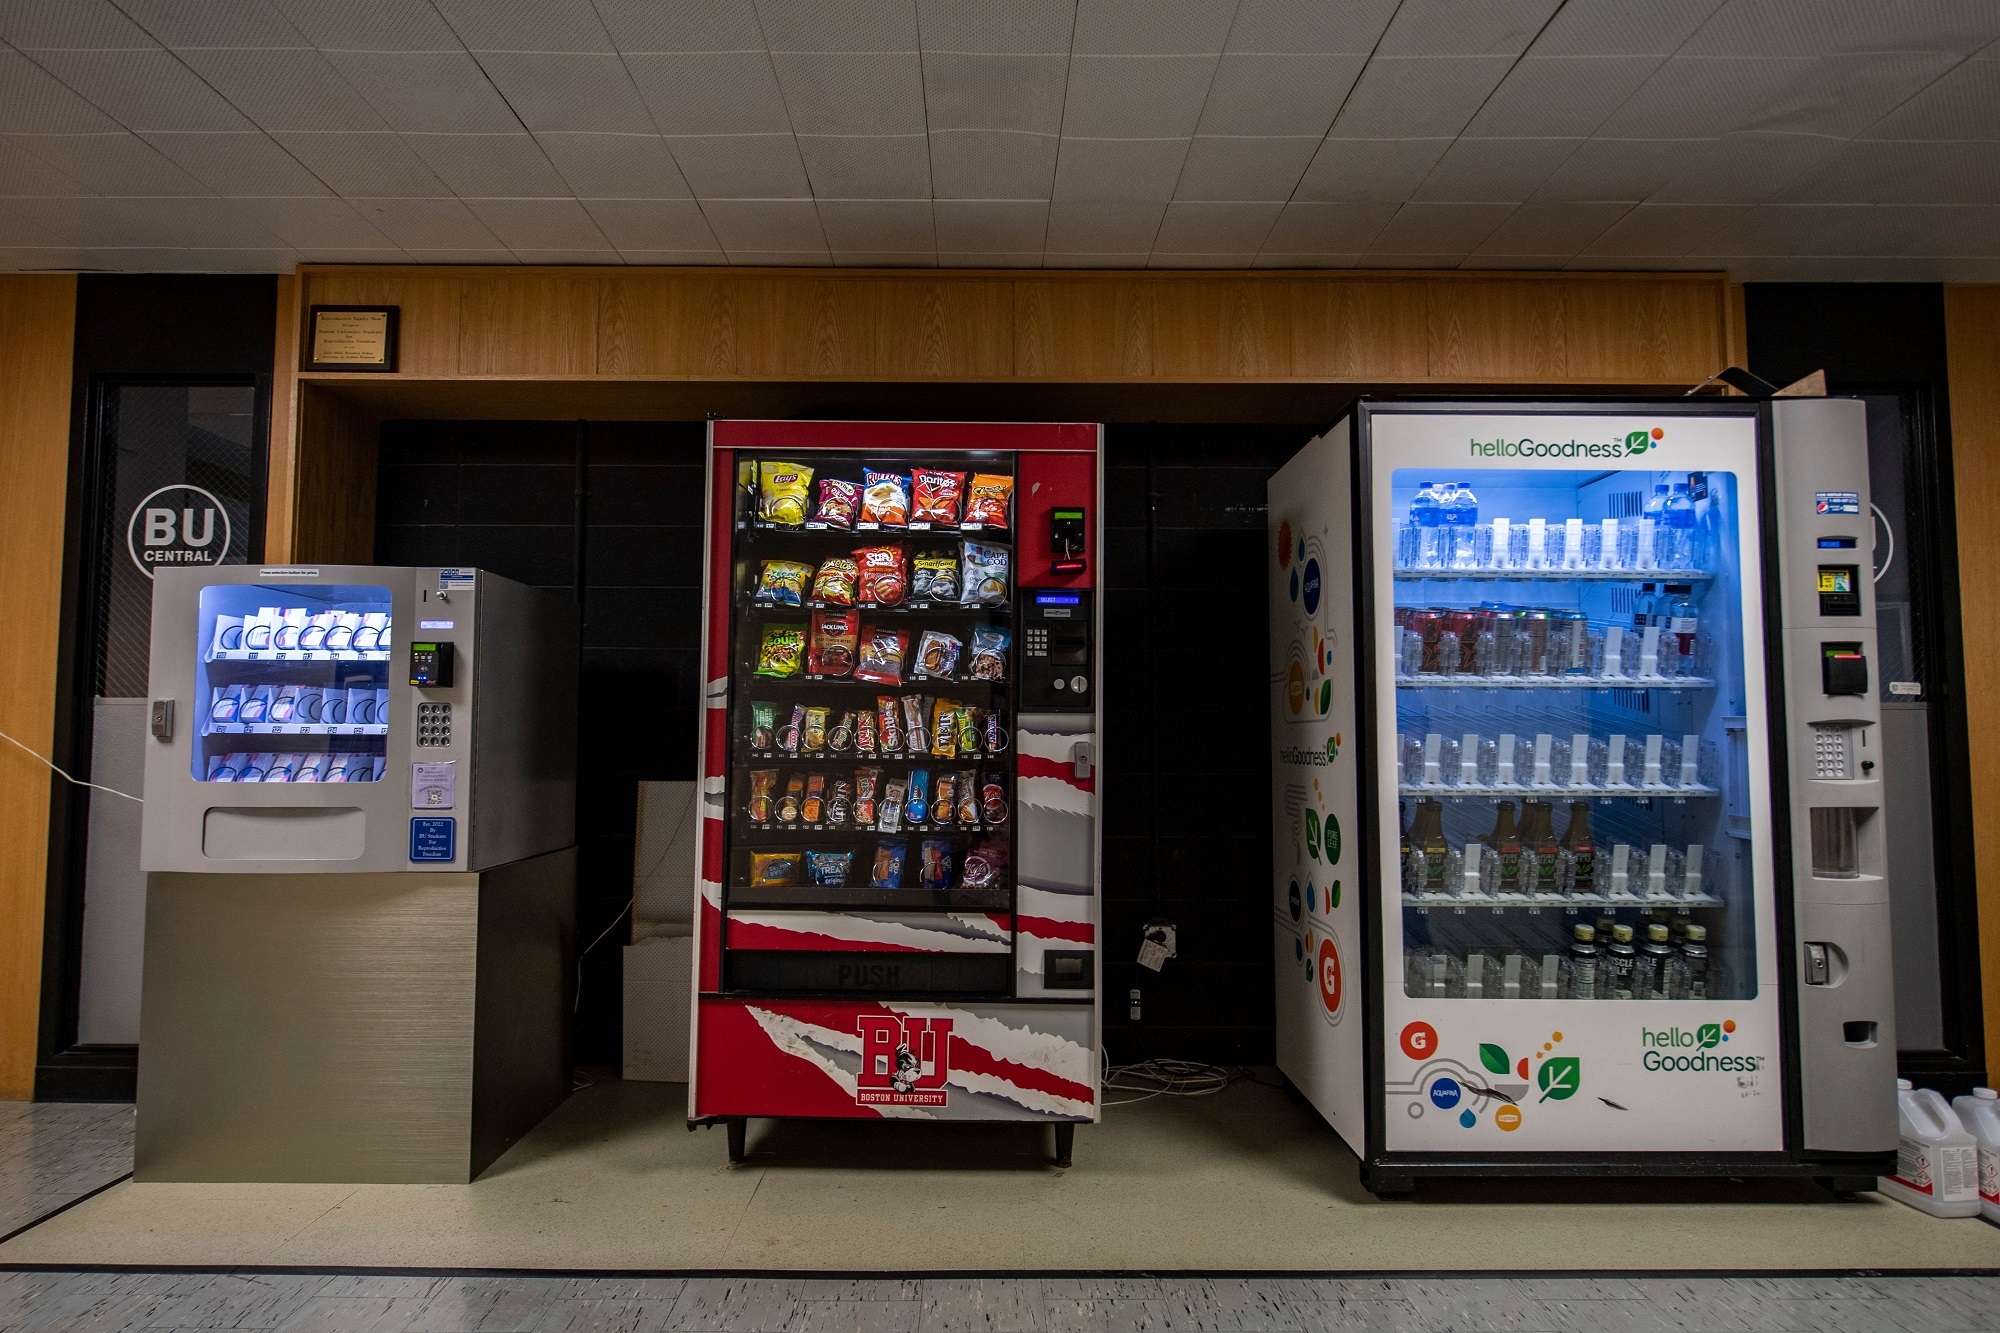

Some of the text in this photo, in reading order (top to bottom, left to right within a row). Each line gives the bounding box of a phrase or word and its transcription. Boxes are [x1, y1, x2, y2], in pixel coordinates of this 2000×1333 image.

[1470, 438, 1622, 458] helloGoodness
[775, 474, 798, 483] Lay's
[144, 508, 214, 547] BU
[143, 550, 212, 562] CENTRAL
[984, 551, 1008, 559] CAPE
[766, 636, 797, 647] SOUR
[884, 701, 898, 747] Skittles
[839, 964, 899, 986] PUSH
[1643, 1027, 1694, 1047] hello
[857, 1015, 954, 1090] BU
[1643, 1050, 1756, 1072] Goodness
[894, 1094, 943, 1103] UNIVERSITY
[1432, 1089, 1458, 1098] AQUAFINA
